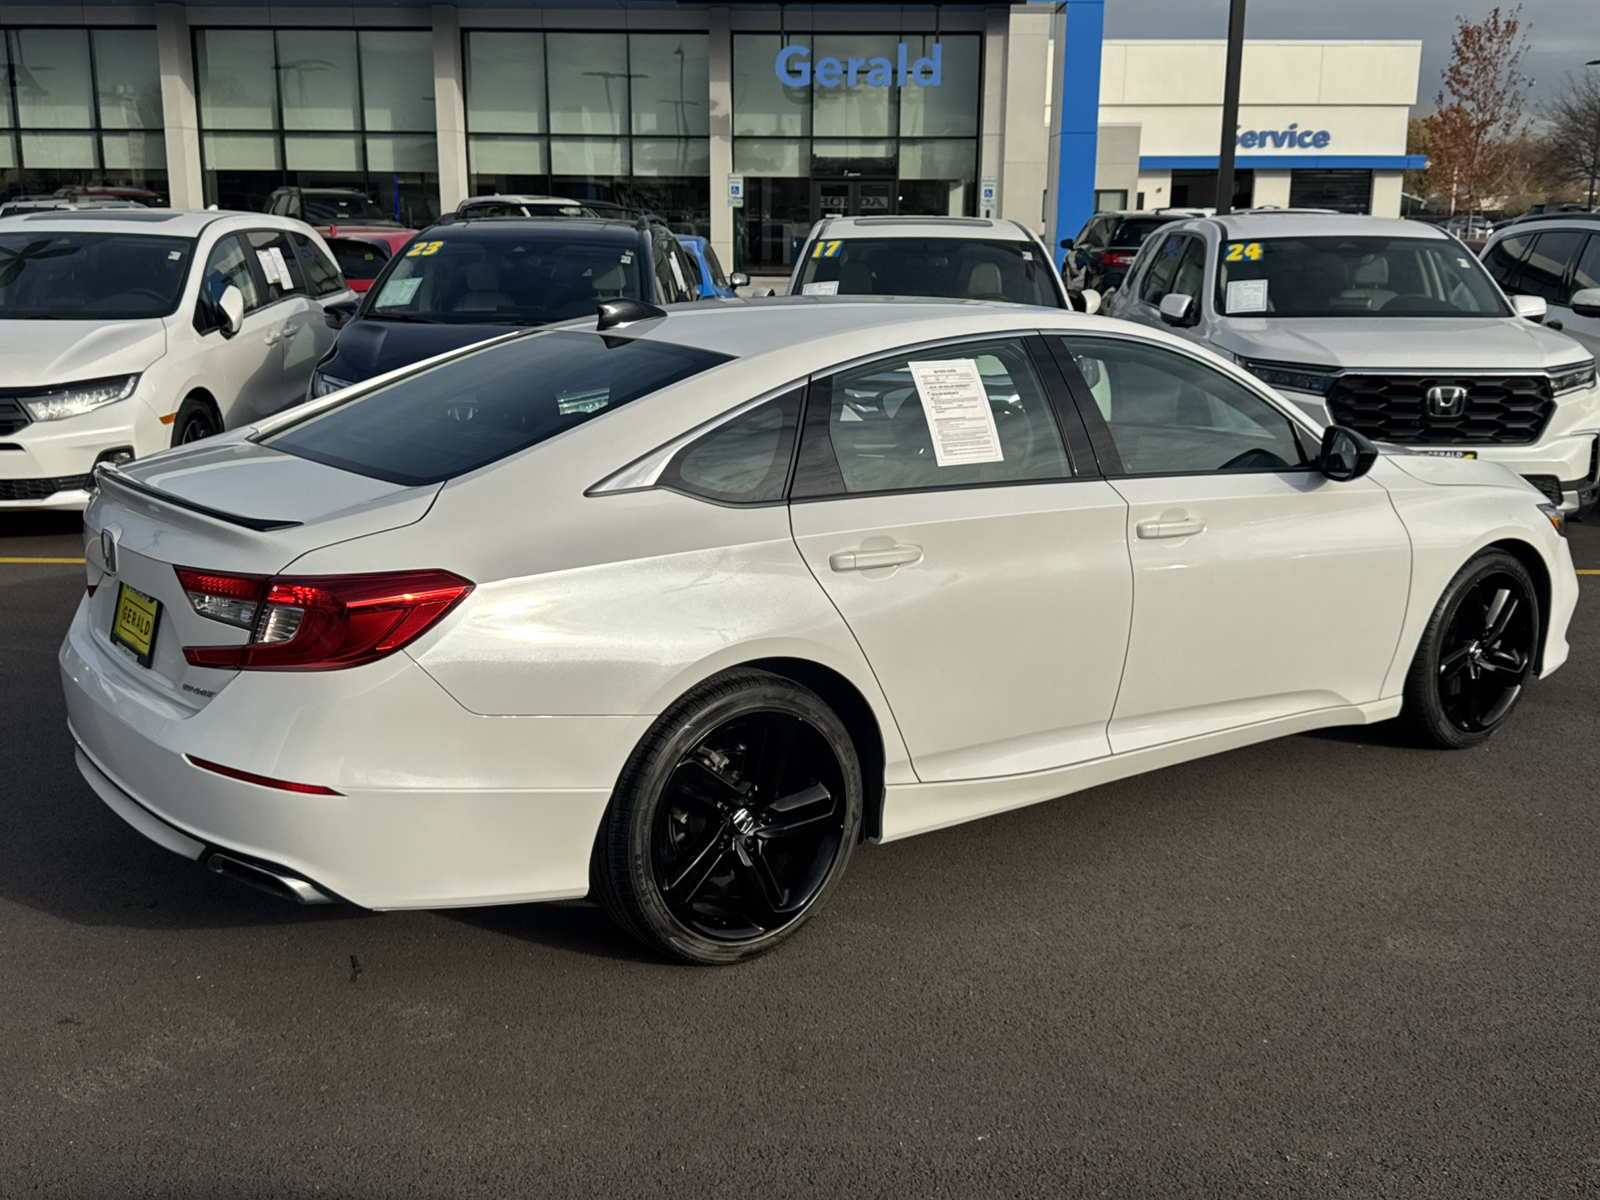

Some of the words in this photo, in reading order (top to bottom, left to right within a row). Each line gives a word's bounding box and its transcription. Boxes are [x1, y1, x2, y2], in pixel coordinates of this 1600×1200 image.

[775, 43, 943, 88] Gerald
[406, 241, 443, 257] 23
[812, 241, 842, 258] 17
[1226, 243, 1264, 261] 24
[122, 605, 151, 636] GERALD
